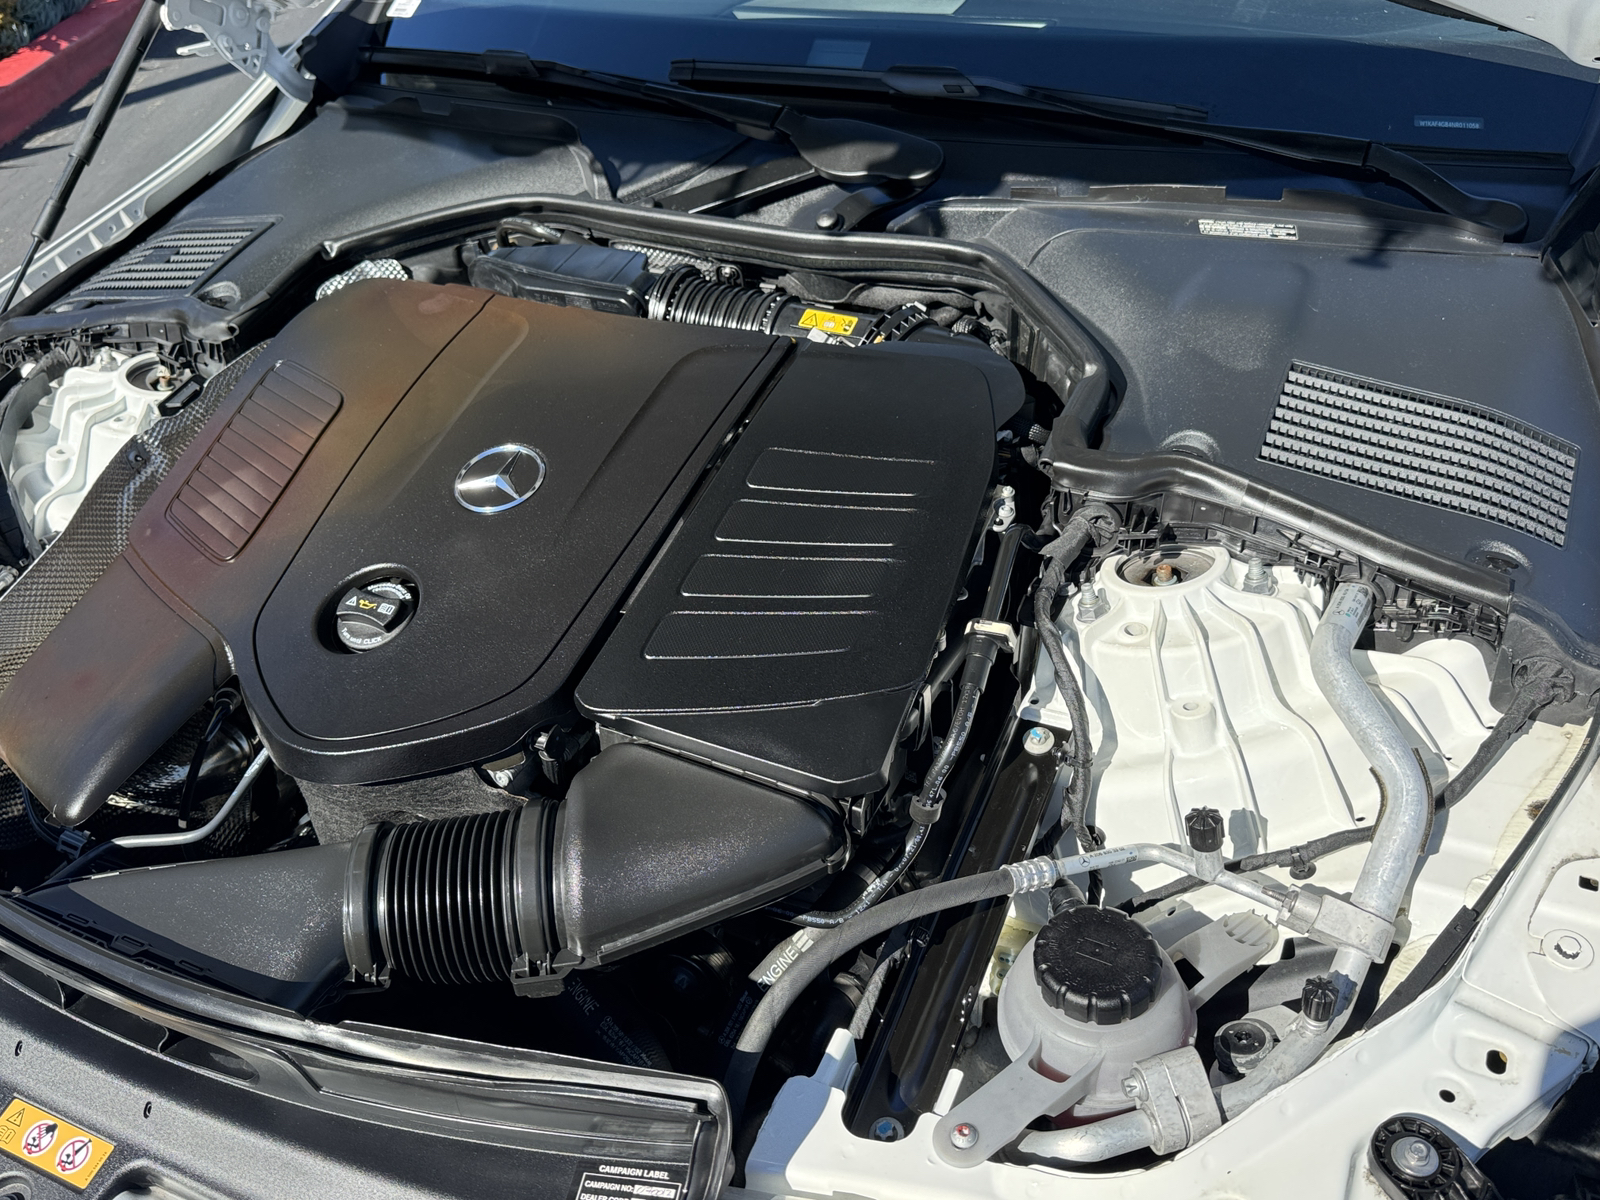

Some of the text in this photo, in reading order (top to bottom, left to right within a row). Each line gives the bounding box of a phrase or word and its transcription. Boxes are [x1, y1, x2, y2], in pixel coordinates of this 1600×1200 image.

[363, 636, 382, 645] CLICK
[757, 945, 799, 993] ENGINE
[567, 976, 600, 1016] ENGINE
[599, 1164, 670, 1180] CAMPAIGN LABEL
[584, 1180, 620, 1191] CAMPAIGN
[620, 1184, 634, 1193] NO:
